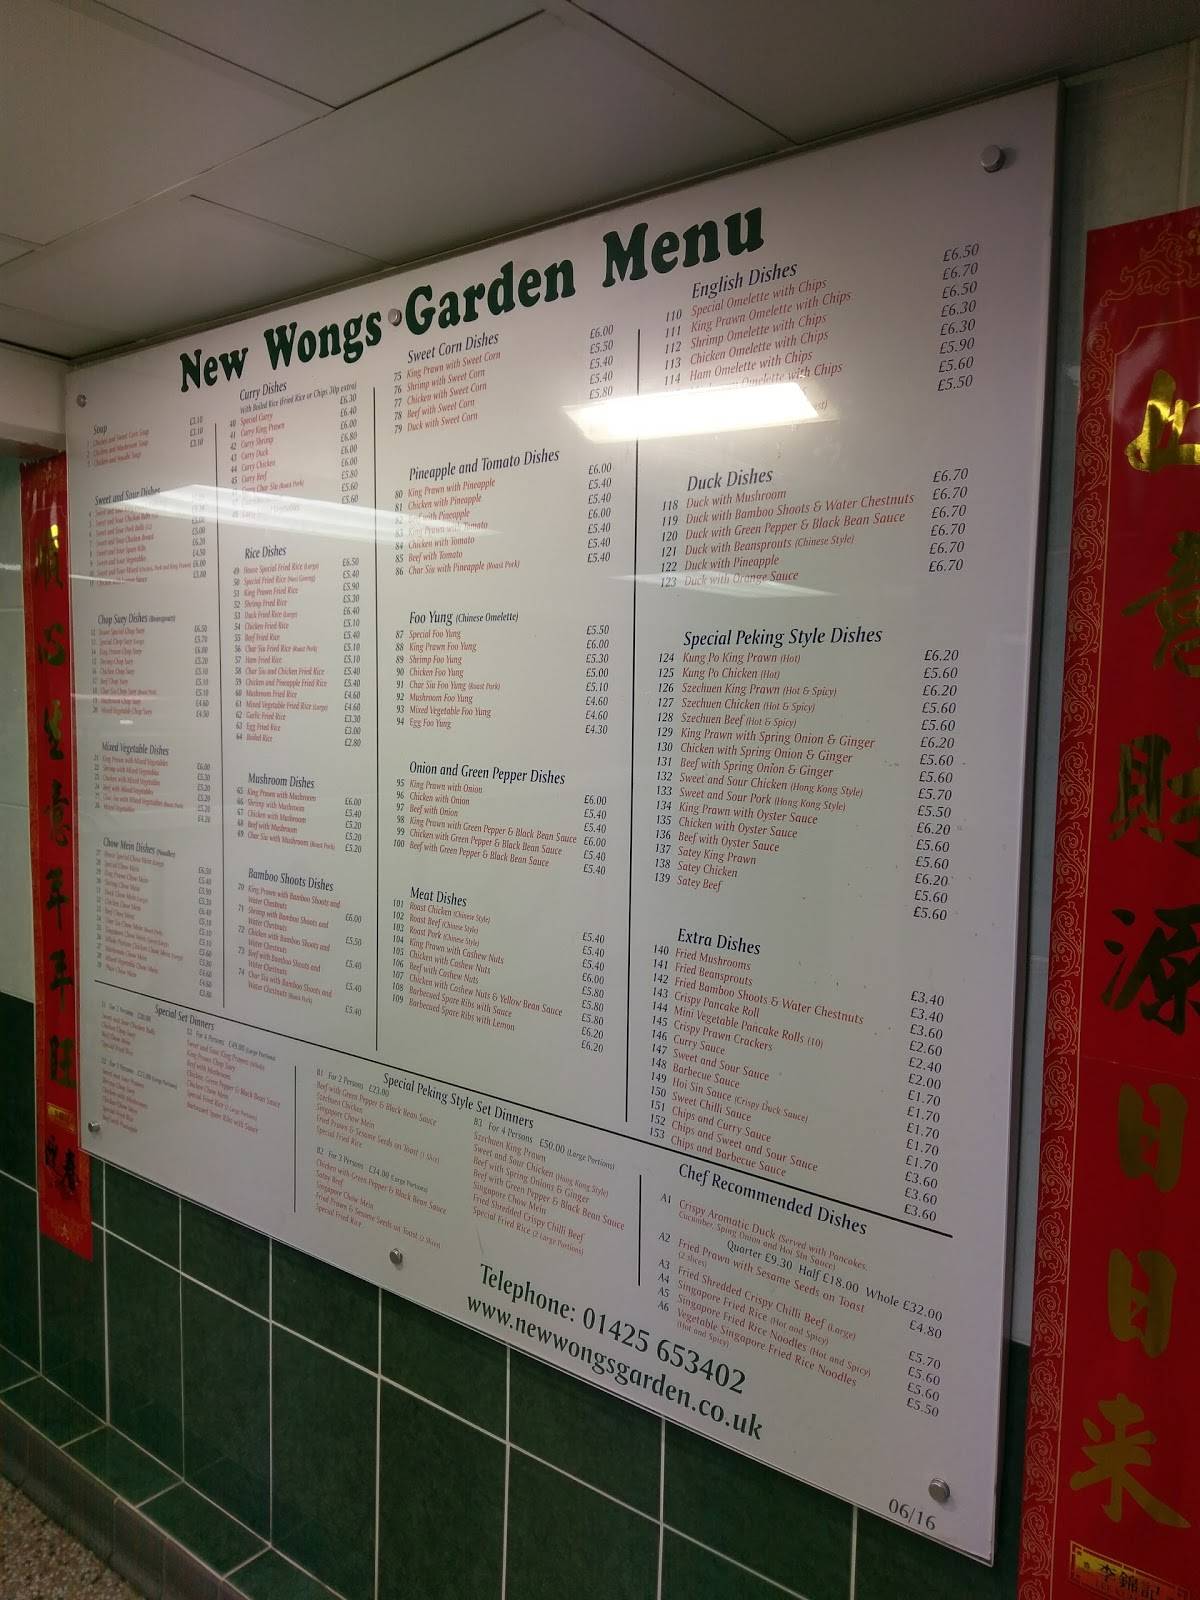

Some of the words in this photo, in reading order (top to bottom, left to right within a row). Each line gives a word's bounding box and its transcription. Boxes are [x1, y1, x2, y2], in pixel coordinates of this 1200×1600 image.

[405, 258, 576, 335] Garden
[602, 206, 765, 288] Menu
[665, 308, 683, 323] 110
[690, 297, 727, 317] Special
[726, 290, 770, 308] Omelette
[772, 283, 795, 300] with
[797, 279, 827, 293] Chips
[942, 243, 979, 262] £6.50
[692, 271, 743, 299] English
[748, 262, 798, 286] Dishes
[393, 370, 402, 382] 75
[406, 367, 424, 380] King
[422, 363, 444, 376] Prawn
[445, 357, 461, 371] with
[461, 352, 483, 368] Sweet
[483, 350, 501, 362] Corn
[589, 324, 614, 340] £6.00
[407, 346, 436, 364] Sweet
[438, 341, 462, 357] Corn
[465, 331, 499, 351] Dishes
[409, 461, 456, 481] Pineapple
[458, 457, 478, 474] and
[481, 455, 521, 472] Tomato
[523, 447, 560, 465] Dishes
[687, 471, 722, 492] Duck
[726, 467, 773, 487] Dishes
[662, 514, 679, 527] 119
[685, 511, 709, 525] Duck
[711, 508, 733, 522] with
[734, 505, 777, 522] Bamboo
[775, 503, 810, 517] Shoots
[812, 500, 823, 513] &
[825, 498, 859, 512] Water
[860, 493, 915, 509] Chestnuts
[932, 485, 968, 501] £6.70
[409, 611, 426, 624] Foo
[429, 610, 454, 626] Yung
[455, 613, 484, 624] (Chinese
[485, 611, 519, 622] Omelette)
[683, 629, 732, 649] Special
[735, 628, 785, 648] Peking
[788, 627, 826, 648] Style
[830, 626, 883, 643] Dishes
[658, 652, 674, 663] 124
[682, 651, 708, 666] Kung
[706, 651, 723, 665] Po
[720, 650, 747, 665] King
[745, 650, 779, 665] Prawn
[780, 653, 800, 664] (Hot)
[923, 649, 959, 662] £6.20
[657, 726, 674, 737] 129
[680, 726, 704, 744] King
[703, 727, 735, 742] Prawn
[735, 729, 759, 742] with
[757, 729, 794, 747] Spring
[793, 730, 824, 745] Onion
[826, 733, 837, 746] &
[838, 734, 875, 750] Ginger
[919, 735, 955, 750] £6.20
[409, 760, 437, 775] Onion
[439, 763, 459, 777] and
[461, 764, 489, 779] Green
[492, 766, 528, 784] Pepper
[530, 769, 566, 785] Dishes
[410, 886, 434, 902] Meat
[436, 890, 467, 908] Dishes
[655, 857, 671, 870] 138
[676, 859, 702, 875] Satey
[702, 862, 738, 878] Chicken
[913, 889, 948, 904] £5.60
[677, 927, 712, 947] Extra
[716, 934, 760, 955] Dishes
[653, 944, 669, 956] 140
[675, 947, 698, 961] Fried
[698, 950, 751, 971] Mushrooms
[910, 990, 945, 1007] £3.40
[392, 981, 404, 992] 108
[407, 984, 441, 1001] Barbecued
[440, 992, 460, 1006] Spare
[460, 997, 477, 1011] Ribs
[475, 1000, 493, 1014] with
[491, 1004, 512, 1018] Sauce
[581, 1025, 604, 1040] £6.20
[653, 986, 669, 999] 143
[674, 990, 703, 1008] Crispy
[703, 996, 740, 1016] Pancake
[740, 1004, 760, 1019] Roll
[909, 1039, 943, 1057] £2.60
[383, 1072, 415, 1092] Special
[416, 1082, 449, 1105] Peking
[449, 1092, 474, 1110] Style
[475, 1100, 491, 1116] Set
[493, 1105, 534, 1129] Dinners
[651, 1057, 668, 1070] 148
[671, 1061, 713, 1082] Barbecue
[712, 1072, 740, 1089] Sauce
[906, 1122, 940, 1140] £1.70
[679, 1163, 711, 1187] Chef
[711, 1172, 813, 1218] Recommended
[817, 1205, 867, 1235] Dishes
[726, 1239, 763, 1260] Quarter
[764, 1252, 793, 1271] £9.30
[798, 1263, 822, 1282] Half
[821, 1272, 859, 1293] £18.00
[865, 1286, 899, 1307] Whole
[902, 1299, 943, 1322] £32.00
[480, 1263, 575, 1322] Telephone:
[583, 1307, 650, 1353] 01425
[656, 1339, 746, 1394] 653402
[467, 1296, 763, 1440] www.newwongsgarden.co.uk
[888, 1498, 936, 1531] 06/16
